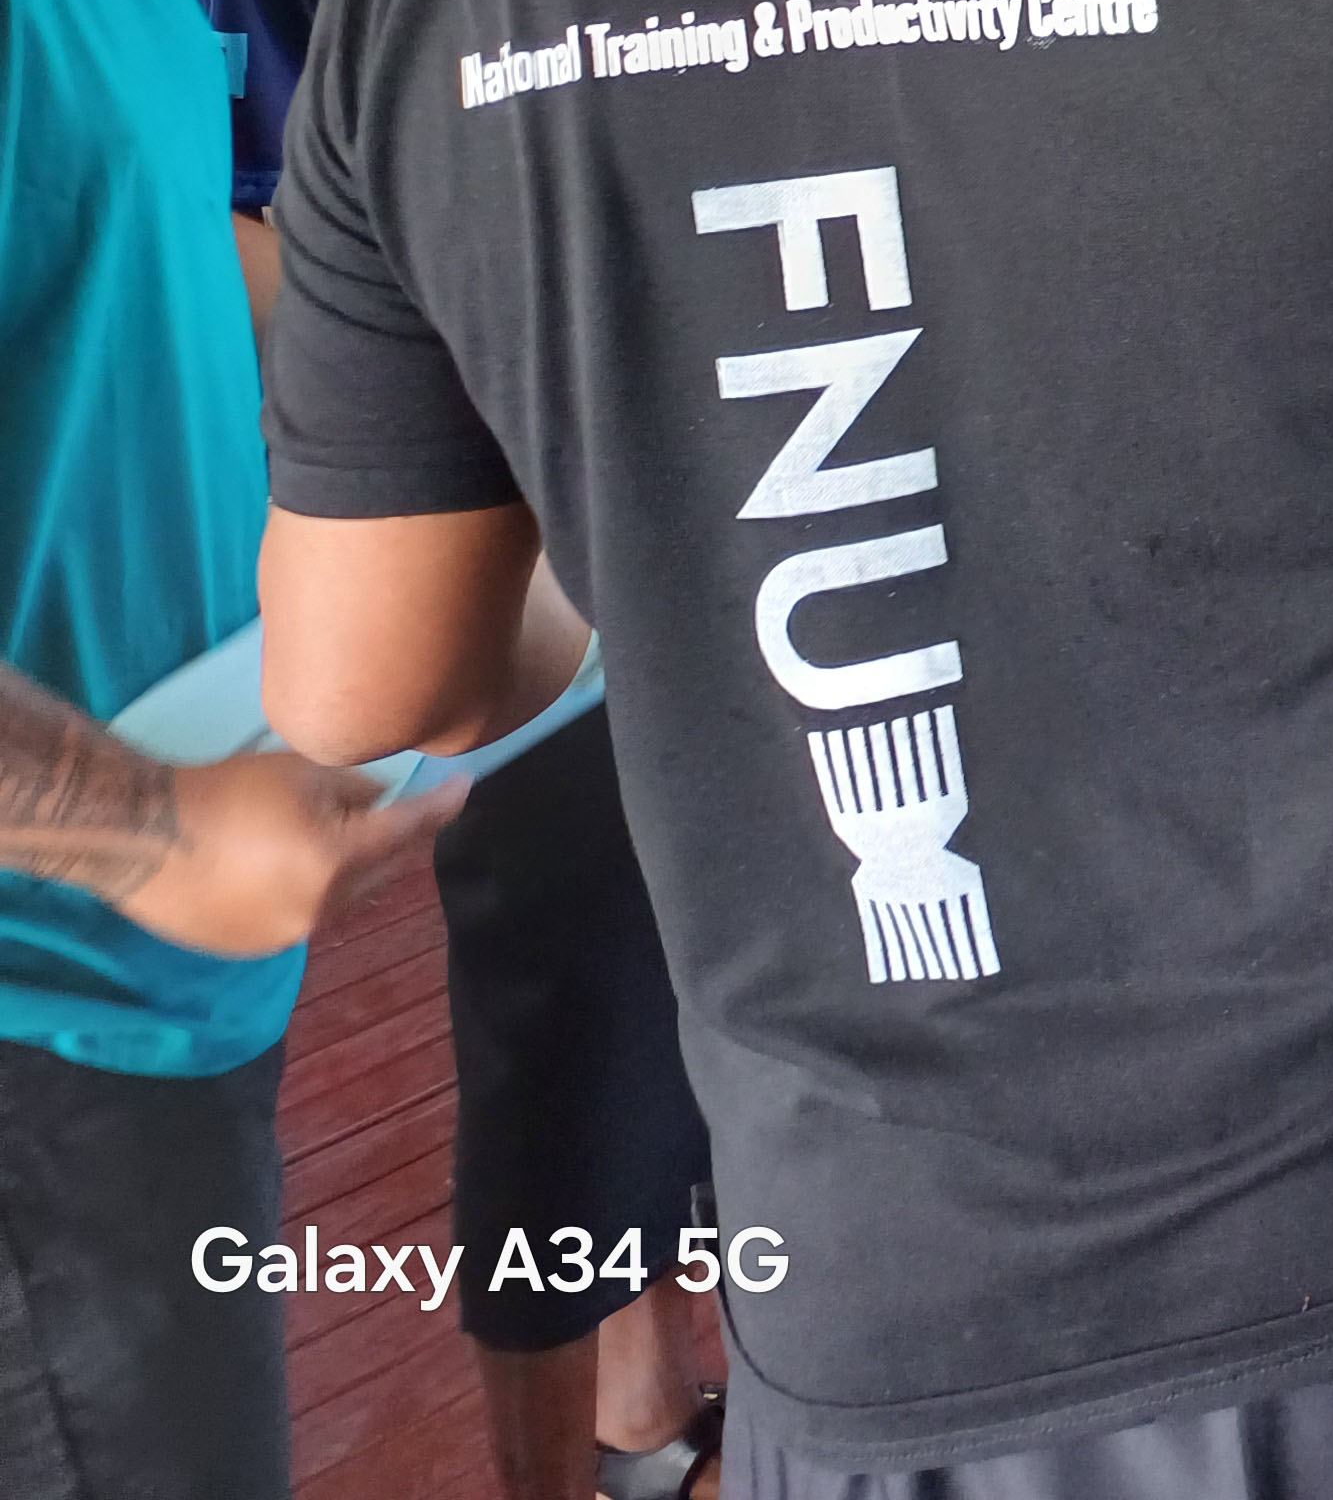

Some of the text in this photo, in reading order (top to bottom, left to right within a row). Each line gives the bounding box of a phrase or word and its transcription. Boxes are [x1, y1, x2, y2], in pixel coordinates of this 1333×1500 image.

[584, 10, 749, 79] Training
[752, 0, 785, 58] &
[691, 165, 964, 710] FNU
